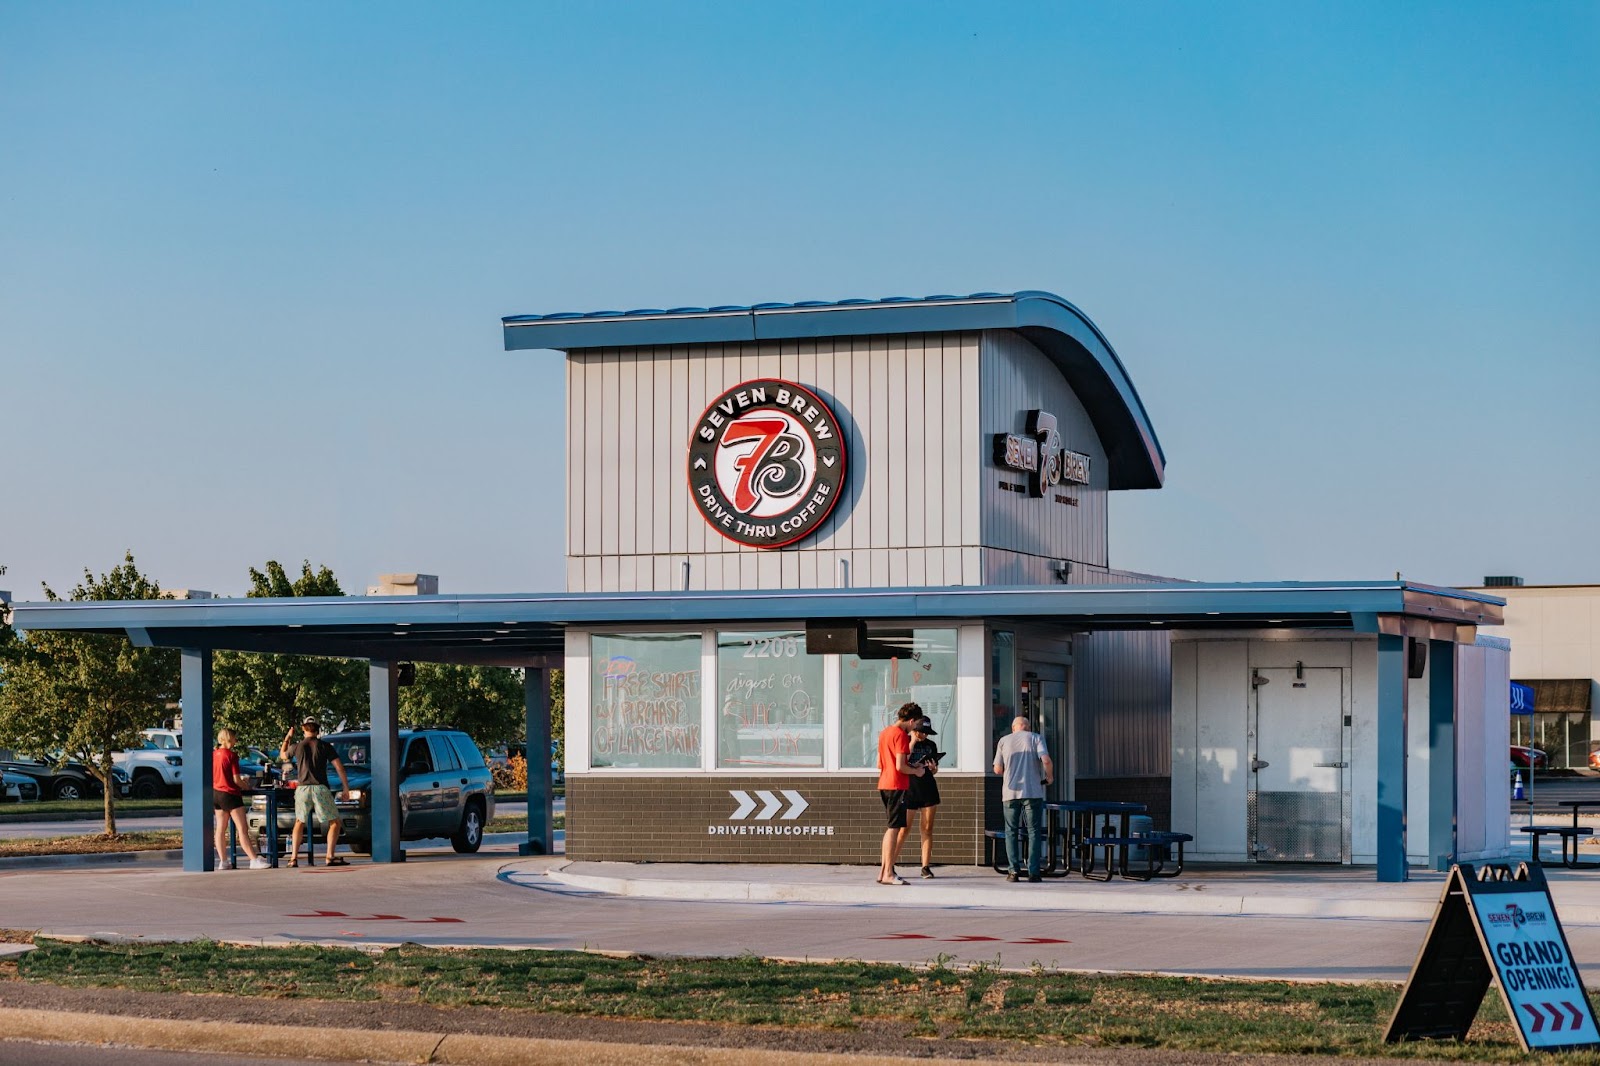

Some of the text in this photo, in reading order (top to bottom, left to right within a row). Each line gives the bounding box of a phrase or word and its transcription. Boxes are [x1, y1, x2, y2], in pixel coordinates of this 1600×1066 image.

[699, 387, 833, 441] SEVEN BREW
[720, 417, 806, 514] 7B
[698, 483, 830, 537] DRIVE THRU COFFEE
[743, 636, 798, 657] 2208
[602, 669, 700, 701] FREE SHIRT
[621, 699, 688, 724] PURCHASE
[617, 725, 661, 755] LARGE
[664, 723, 701, 757] DRINK
[1488, 913, 1511, 922] SEVEN
[1525, 911, 1547, 921] BREW
[1497, 941, 1563, 966] GRAND
[1506, 967, 1574, 992] OPENING!
